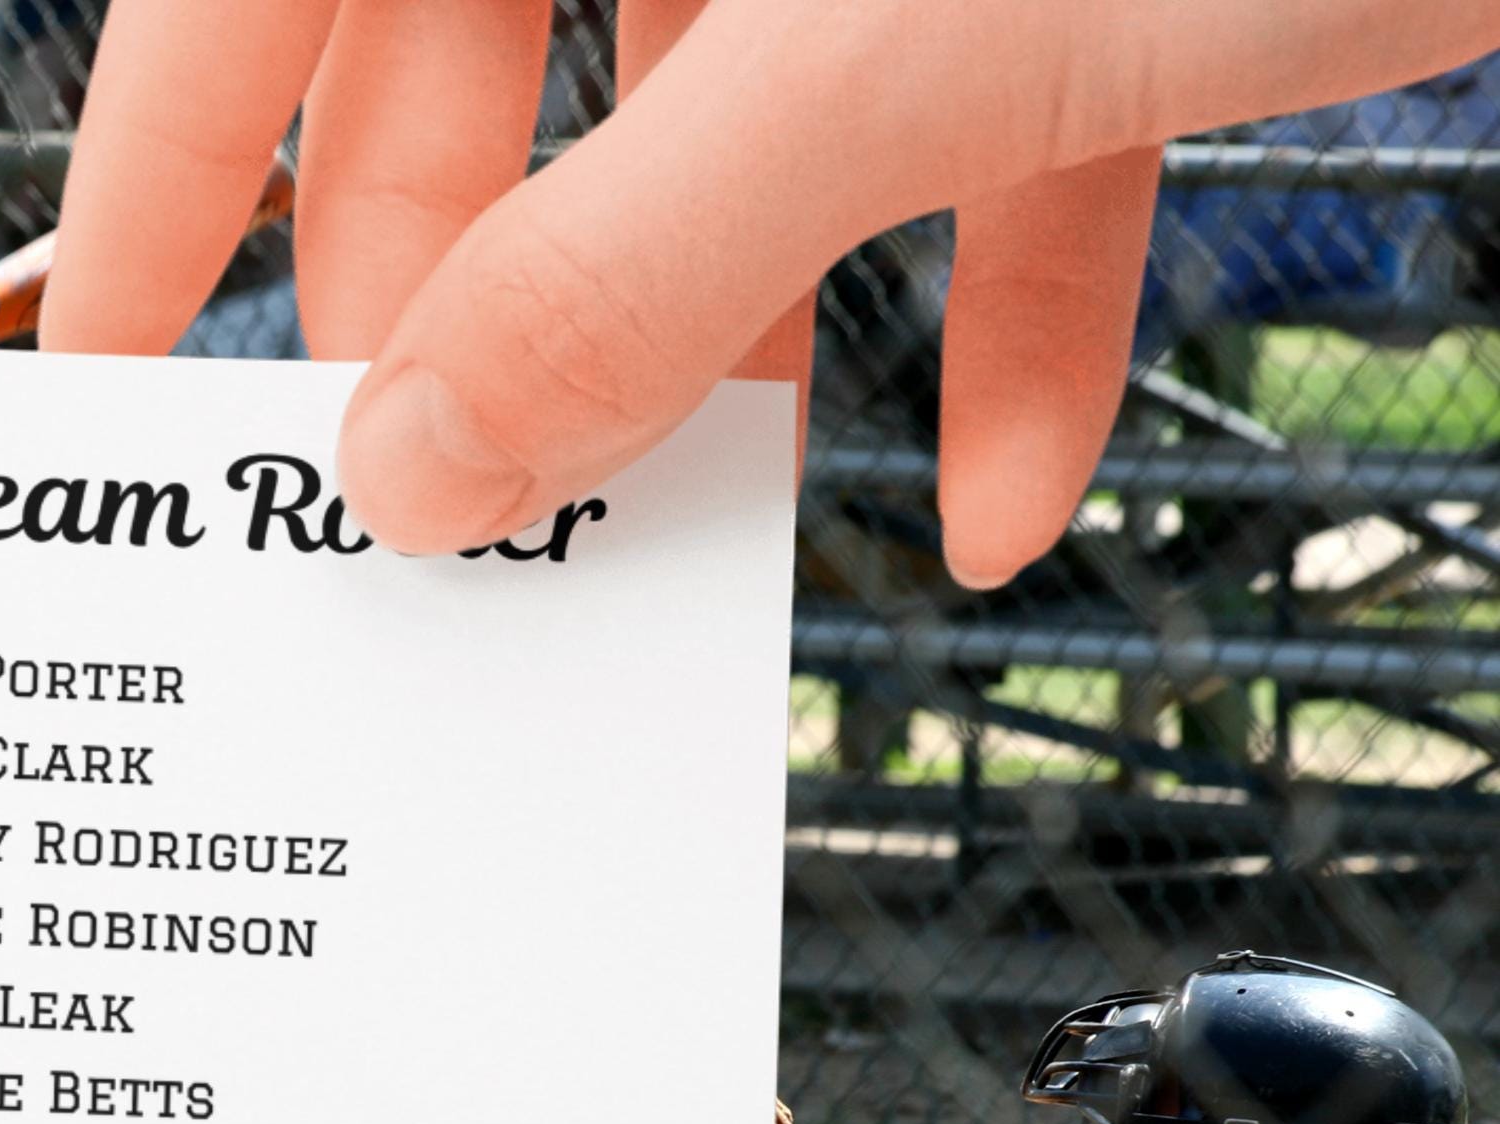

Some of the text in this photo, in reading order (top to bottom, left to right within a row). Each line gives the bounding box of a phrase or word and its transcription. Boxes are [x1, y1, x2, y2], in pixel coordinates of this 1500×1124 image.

[226, 453, 607, 562] Ror
[34, 820, 348, 877] RODRIGUEZ
[28, 902, 318, 958] ROBINSON
[49, 1070, 214, 1120] BETTS
